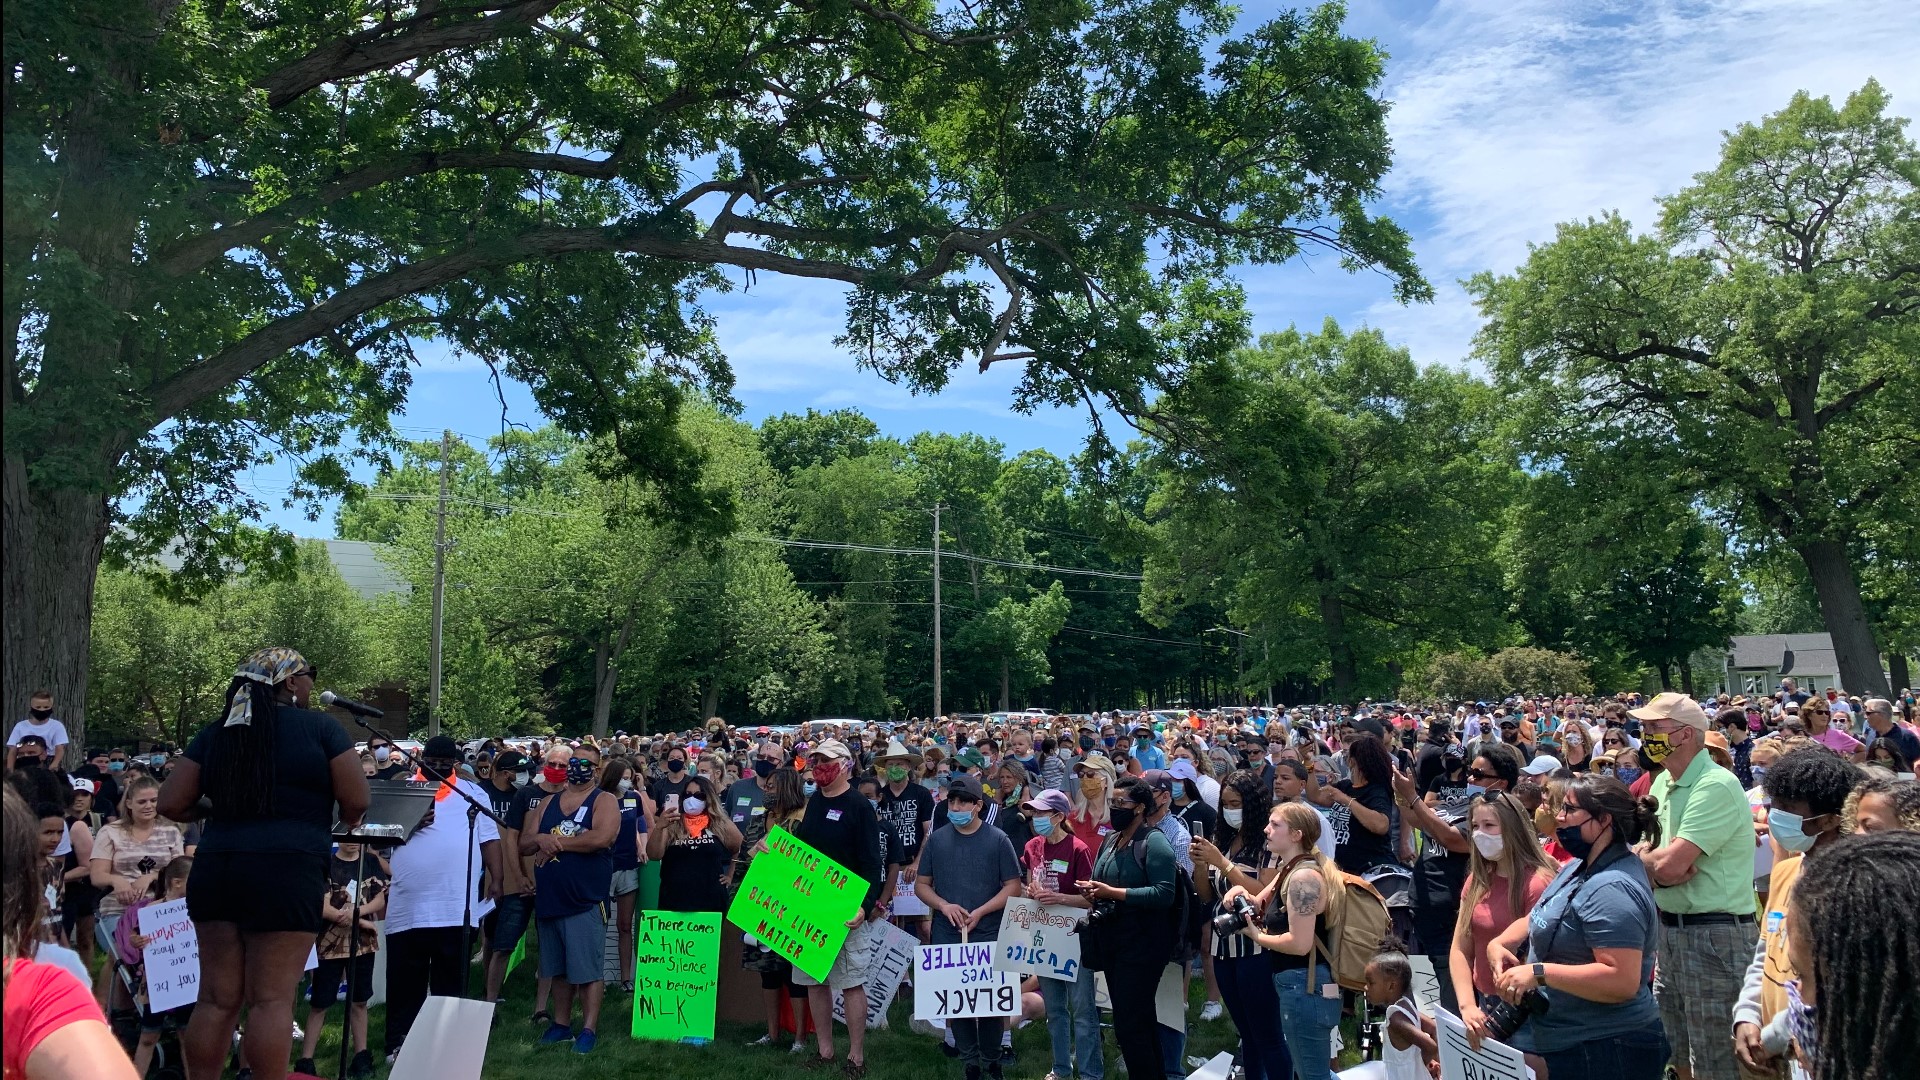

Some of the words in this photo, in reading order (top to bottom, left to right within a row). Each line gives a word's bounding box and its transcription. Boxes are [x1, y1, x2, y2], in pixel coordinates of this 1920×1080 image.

[772, 835, 821, 872] JUSTICE
[823, 865, 848, 890] FOR
[792, 875, 814, 896] ALL
[749, 886, 787, 921] BLACK
[791, 915, 828, 949] LIVES
[642, 932, 653, 945] A
[756, 919, 804, 960] MATTER
[1033, 930, 1044, 947] 4
[639, 954, 665, 964] when
[922, 945, 991, 971] MATTER
[154, 980, 169, 992] be
[177, 973, 197, 989] not
[639, 975, 653, 991] is
[654, 979, 662, 989] a
[934, 985, 1014, 1015] BLACK
[639, 993, 689, 1029] MLK
